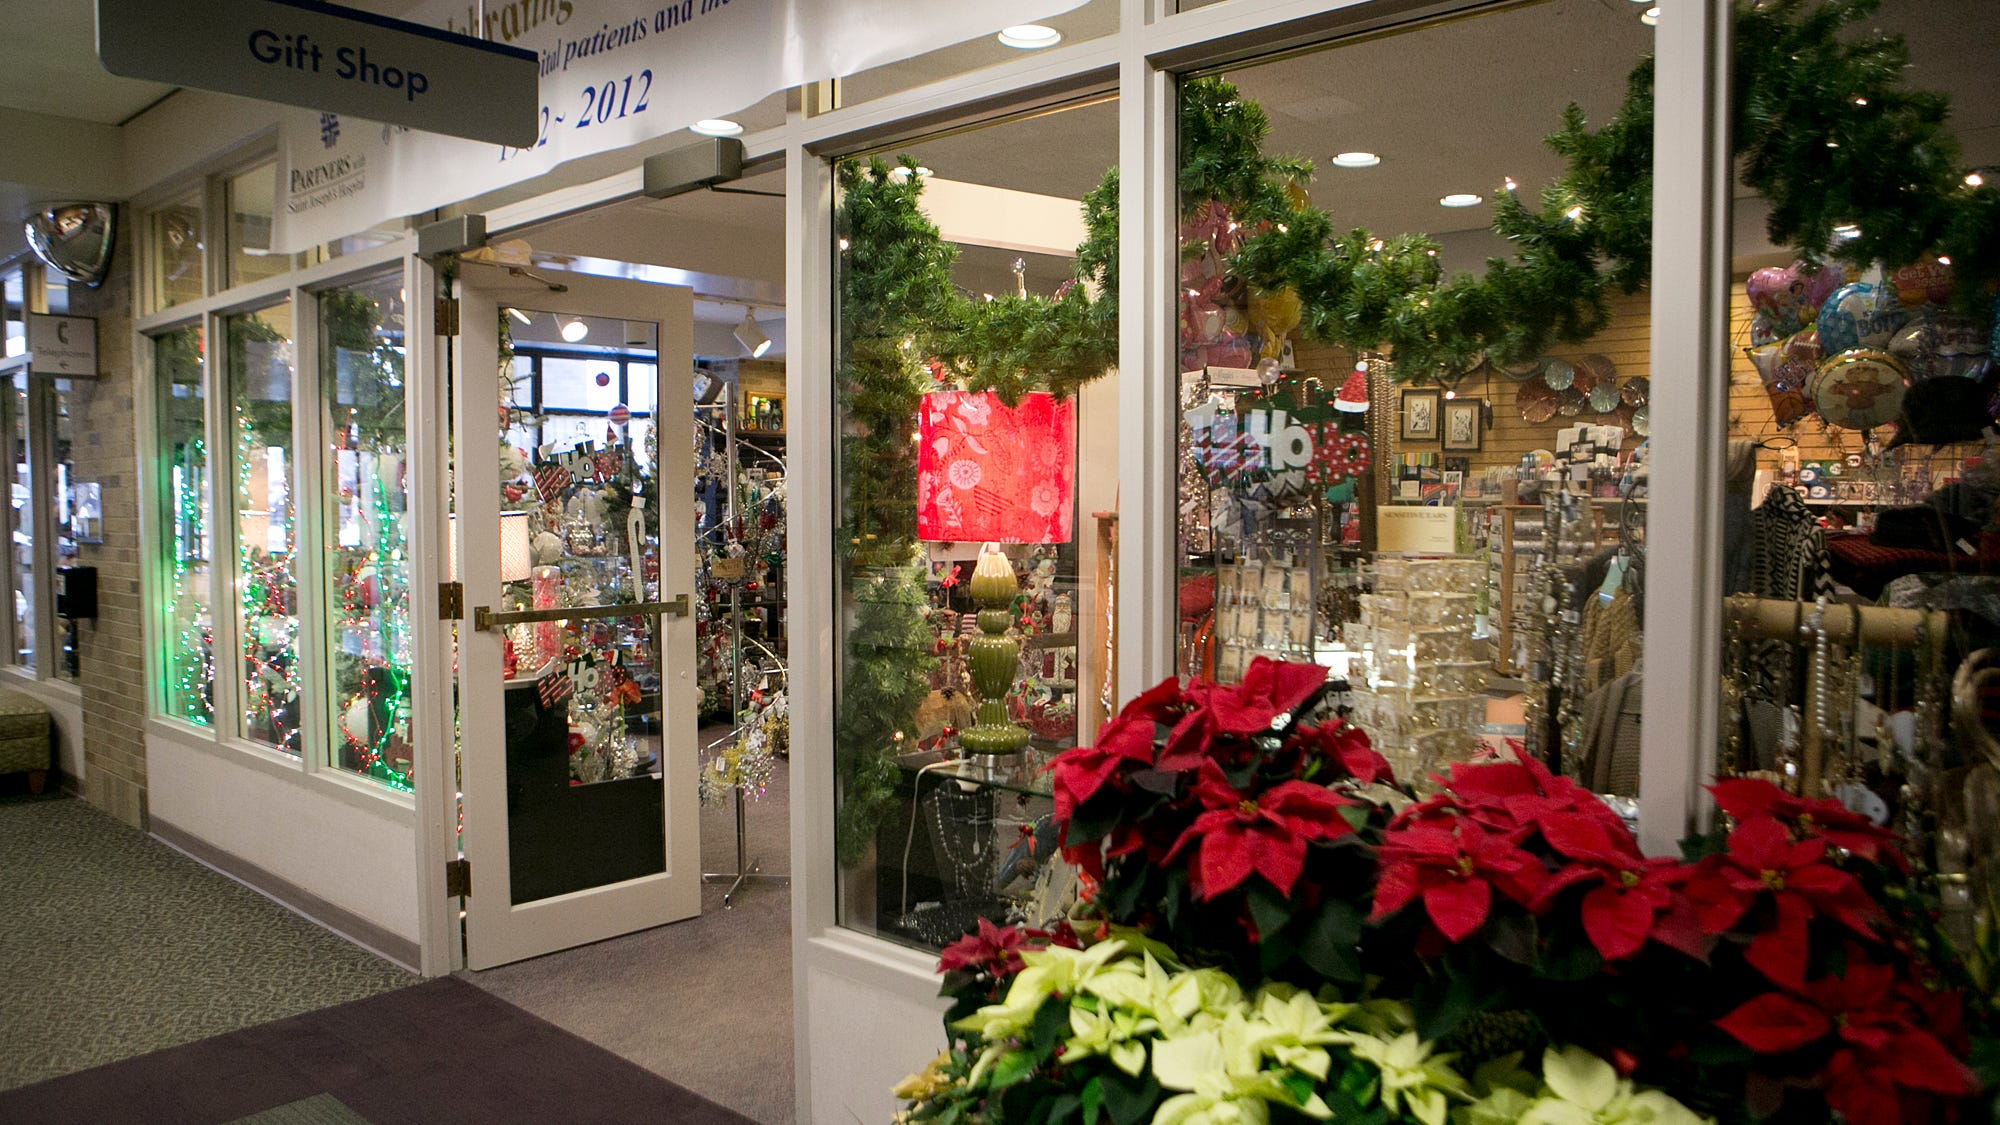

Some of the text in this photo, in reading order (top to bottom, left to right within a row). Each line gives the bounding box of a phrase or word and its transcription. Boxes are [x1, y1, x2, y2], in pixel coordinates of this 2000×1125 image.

[248, 30, 428, 101] Gift Shop
[563, 20, 647, 71] patients
[654, 0, 692, 33] and
[576, 69, 653, 129] 2012
